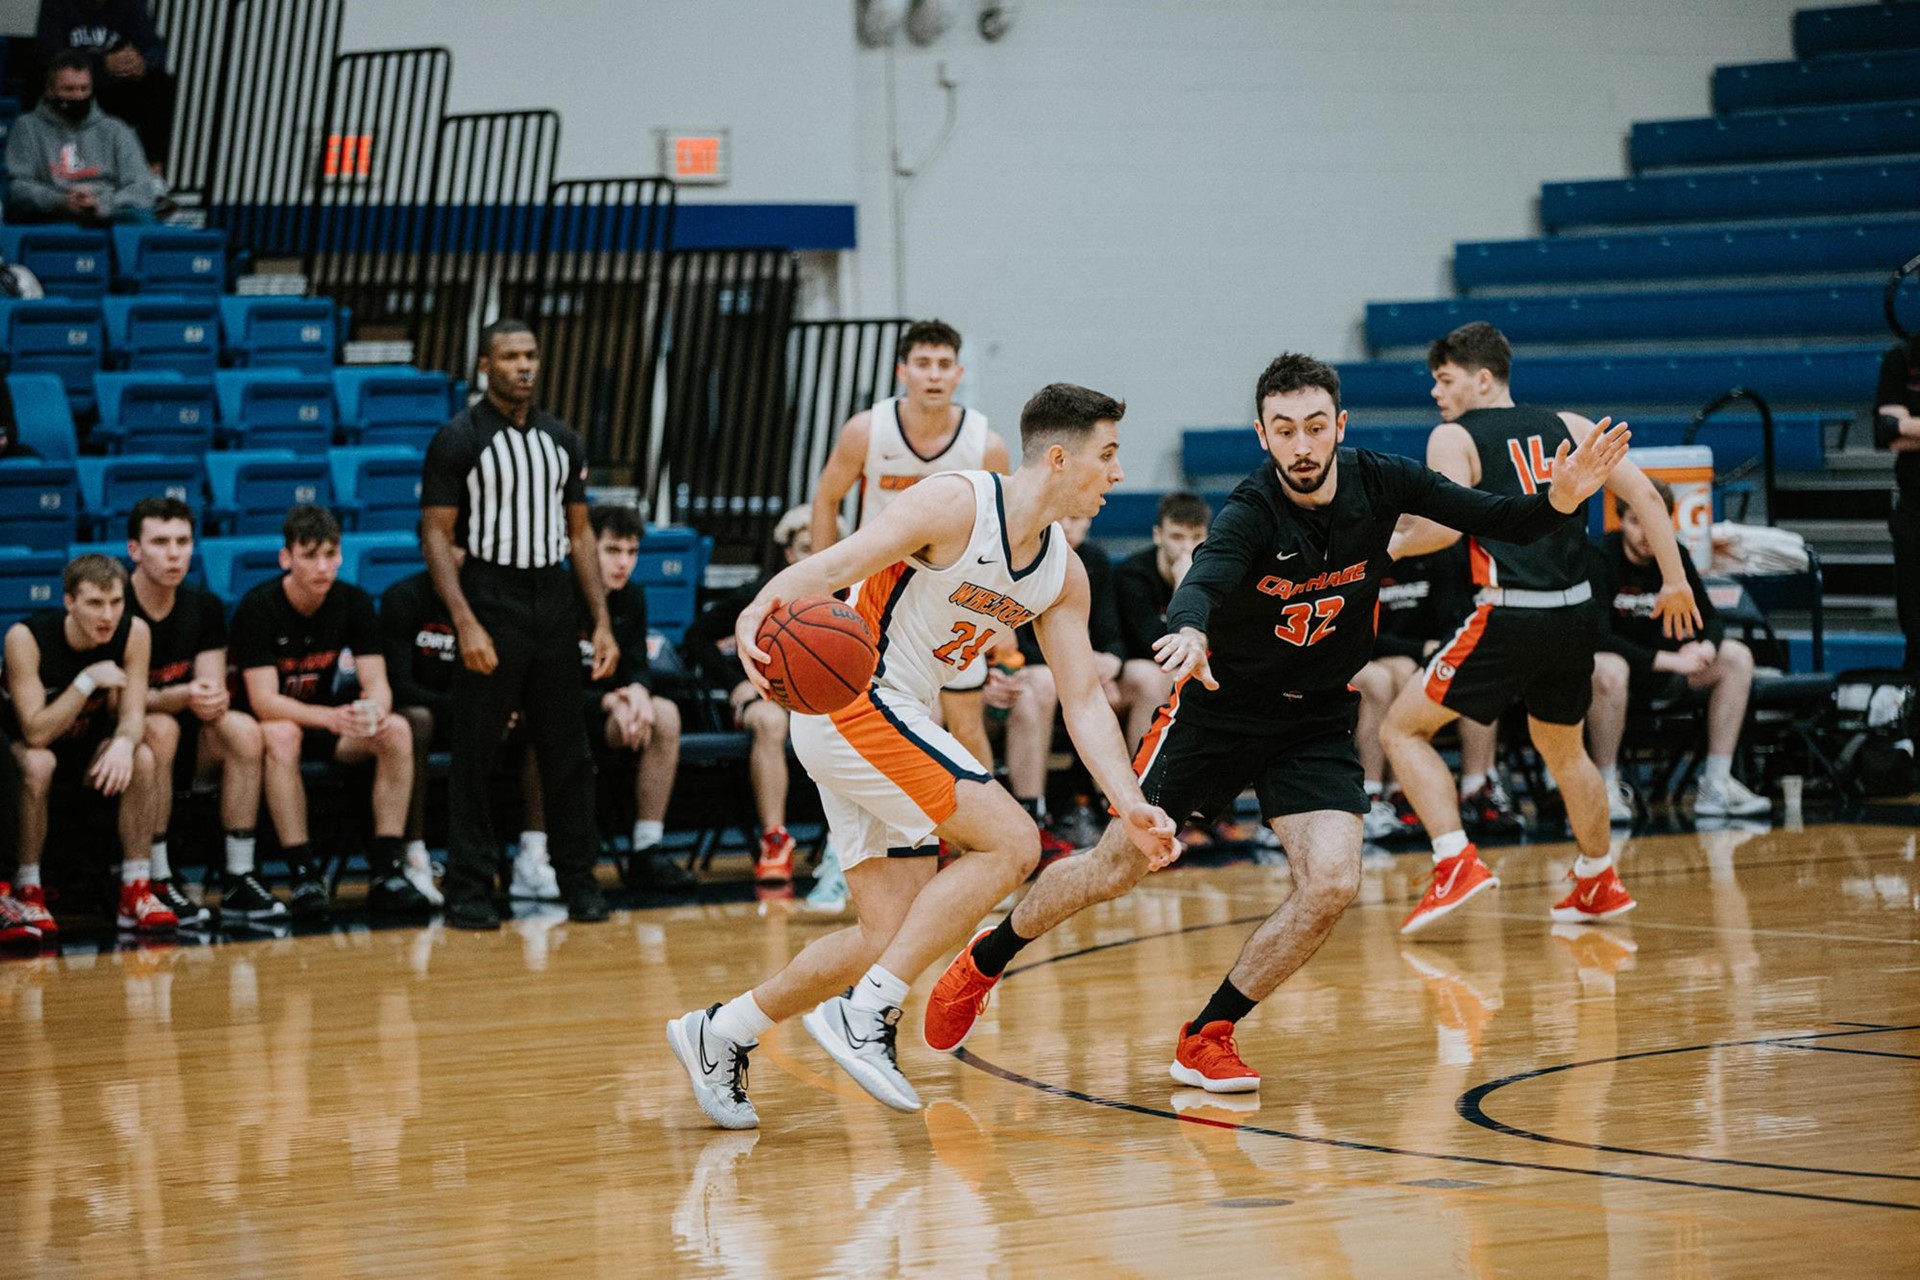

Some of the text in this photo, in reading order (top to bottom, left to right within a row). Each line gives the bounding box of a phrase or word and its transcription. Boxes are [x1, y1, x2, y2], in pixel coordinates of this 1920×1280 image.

[1506, 434, 1556, 496] 14
[1678, 495, 1708, 534] G
[1274, 595, 1345, 647] 32
